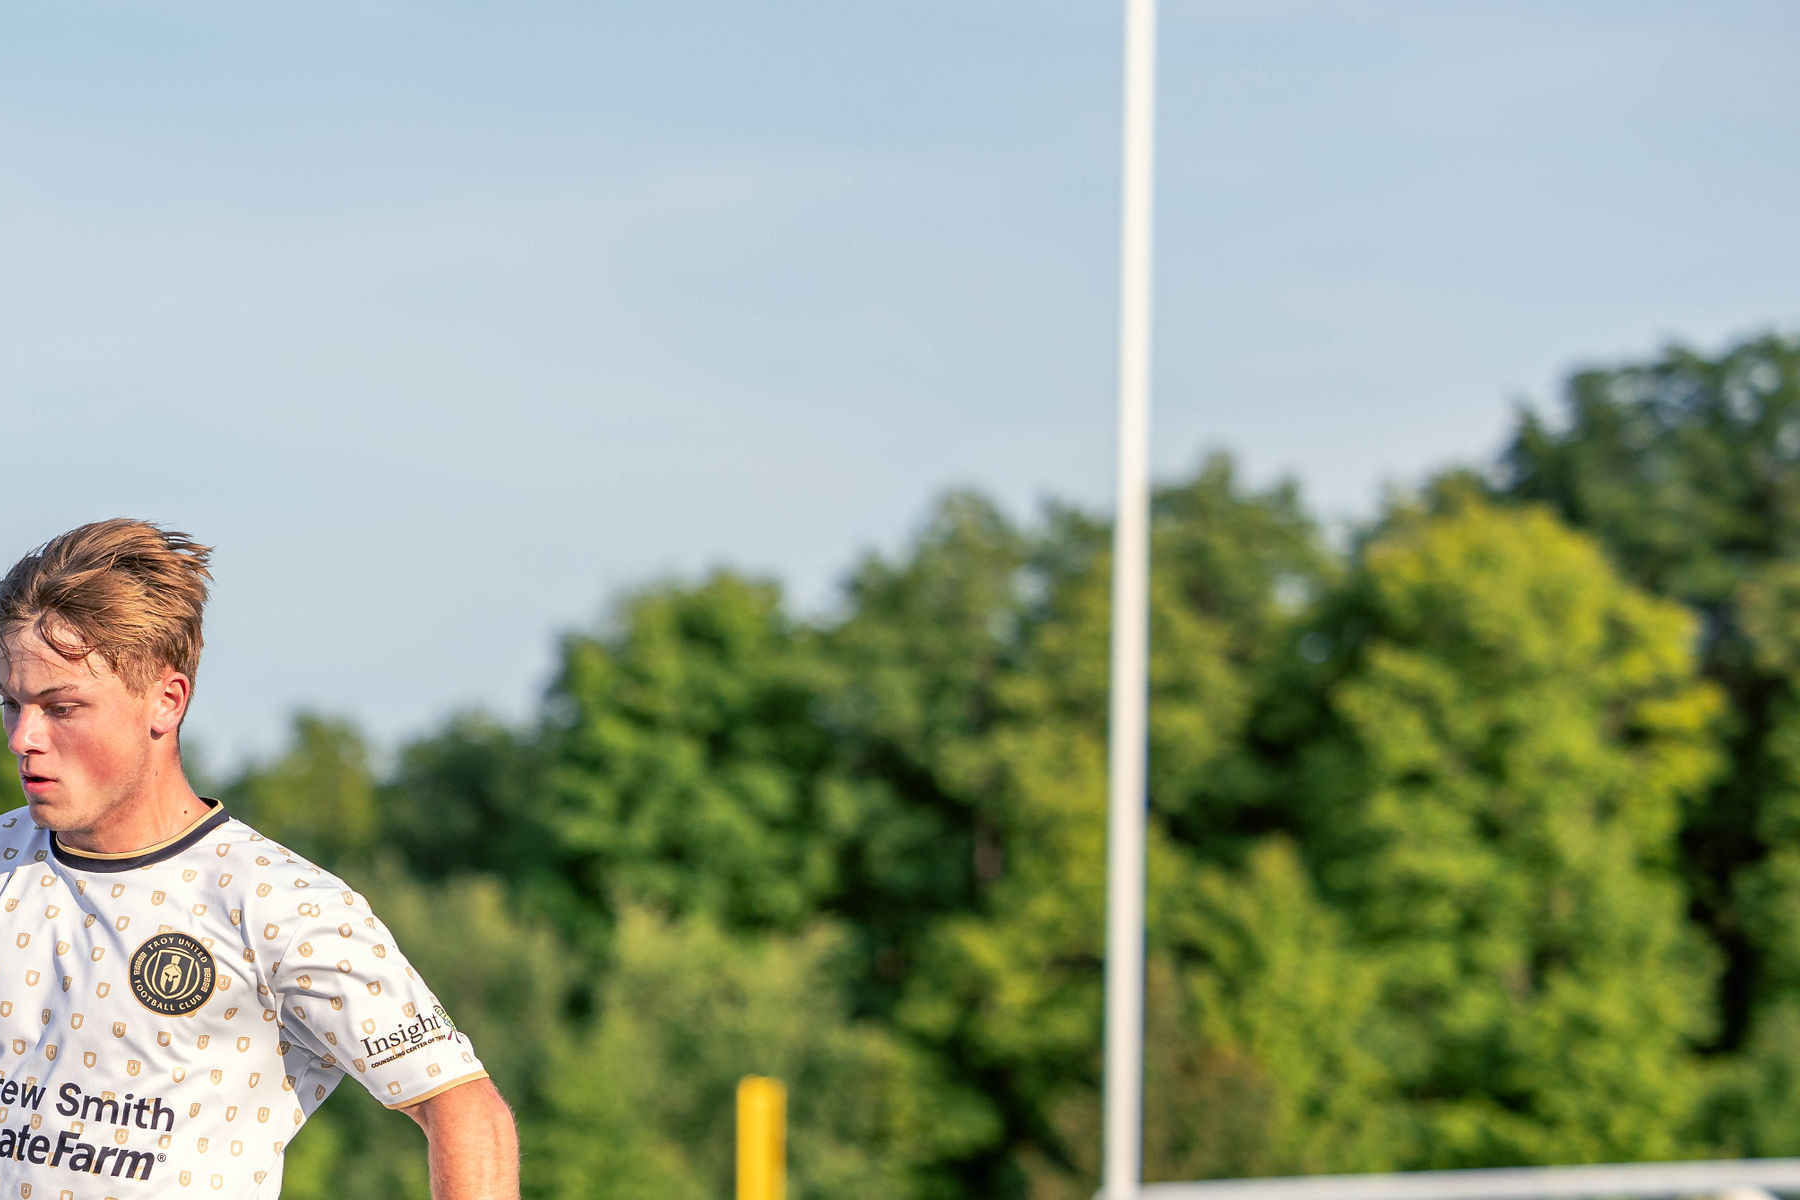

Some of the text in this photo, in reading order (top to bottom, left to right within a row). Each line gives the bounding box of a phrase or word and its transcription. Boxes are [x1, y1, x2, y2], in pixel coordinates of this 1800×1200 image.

[148, 937, 208, 963] TROY UNITED
[134, 979, 202, 1011] FOOTBALL CLUB
[360, 1013, 442, 1058] Insight
[371, 1050, 406, 1069] COUNSELING
[406, 1041, 428, 1054] CENTER
[55, 1082, 175, 1132] Smith
